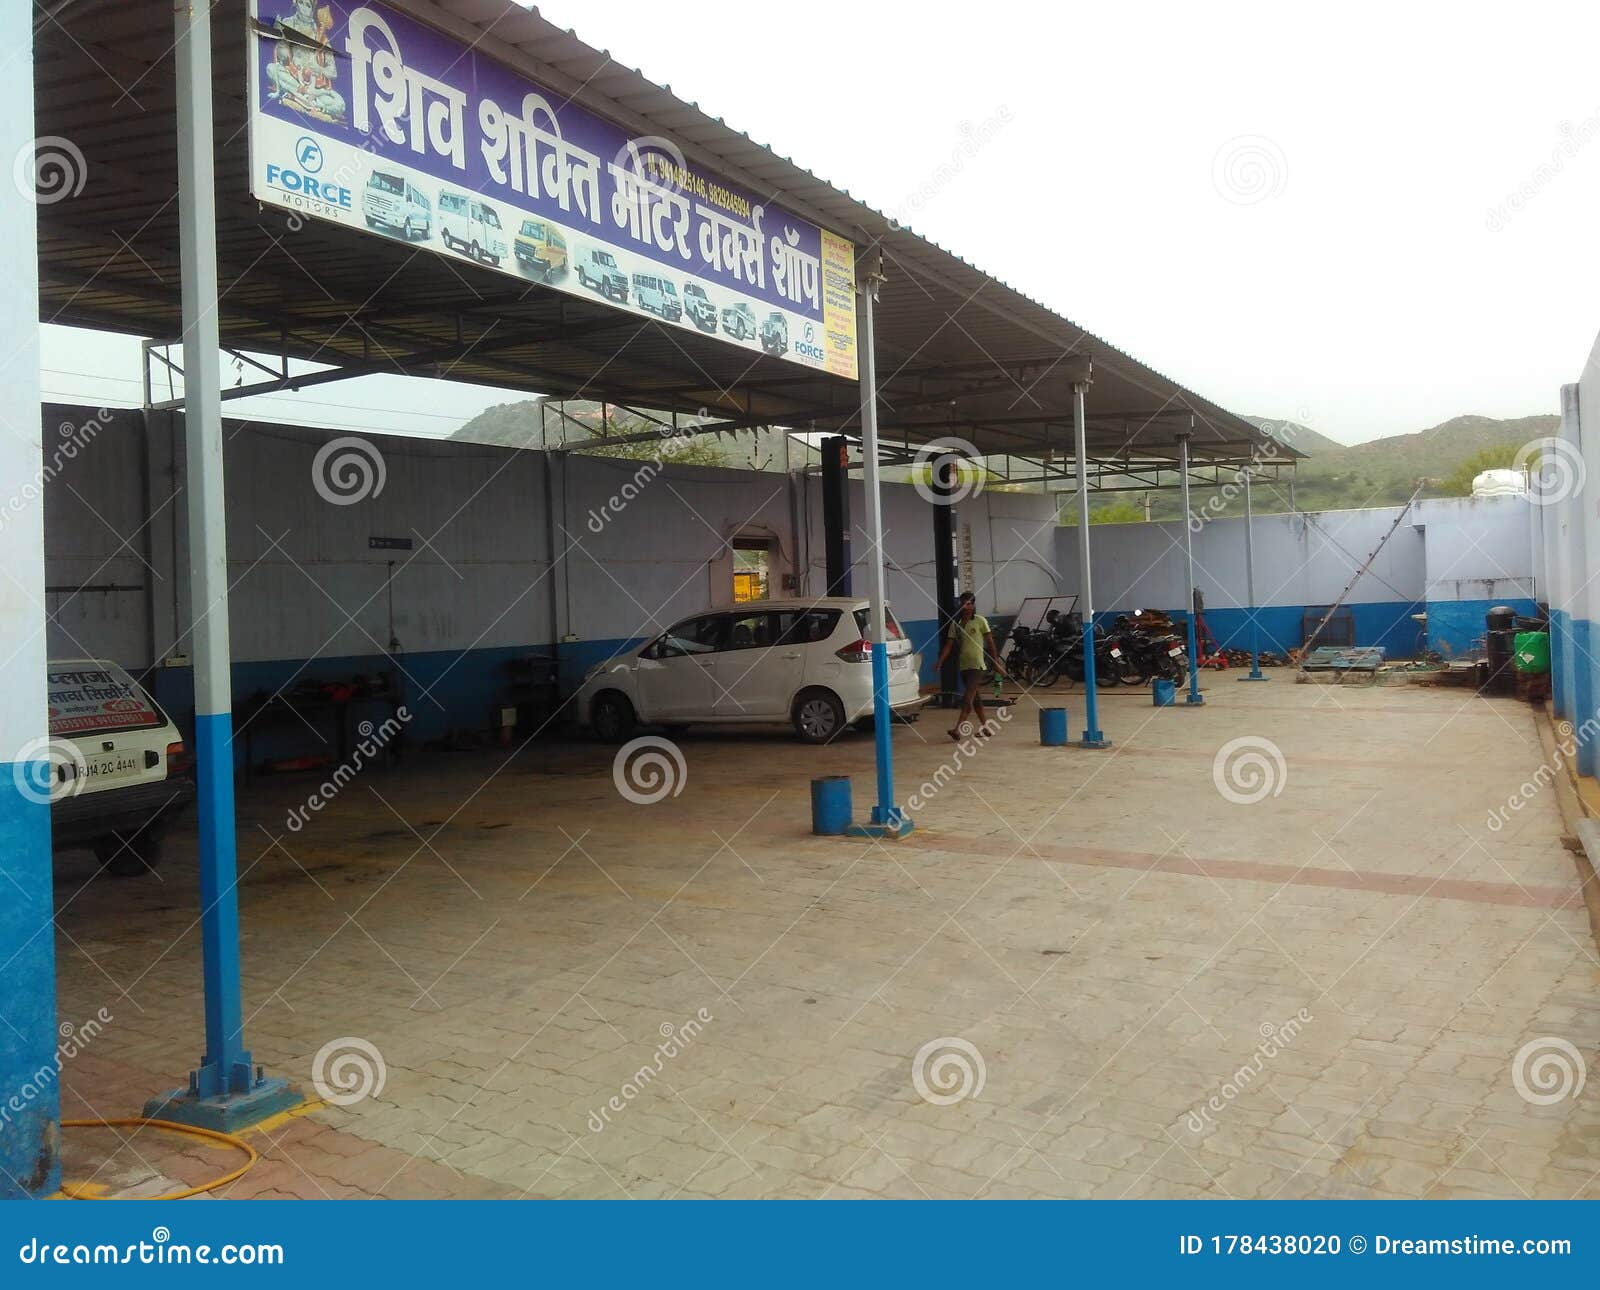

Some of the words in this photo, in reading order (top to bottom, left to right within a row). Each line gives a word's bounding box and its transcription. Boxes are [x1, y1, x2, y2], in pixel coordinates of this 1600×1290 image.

[345, 7, 467, 170] शिव
[479, 93, 600, 225] शक्ति
[608, 138, 692, 260] मोटर
[771, 224, 820, 310] शॉप
[266, 163, 352, 208] FORCE
[282, 194, 339, 218] MOTORS
[794, 341, 825, 361] FORCE
[78, 766, 98, 778] RJ14
[101, 762, 114, 774] 2C
